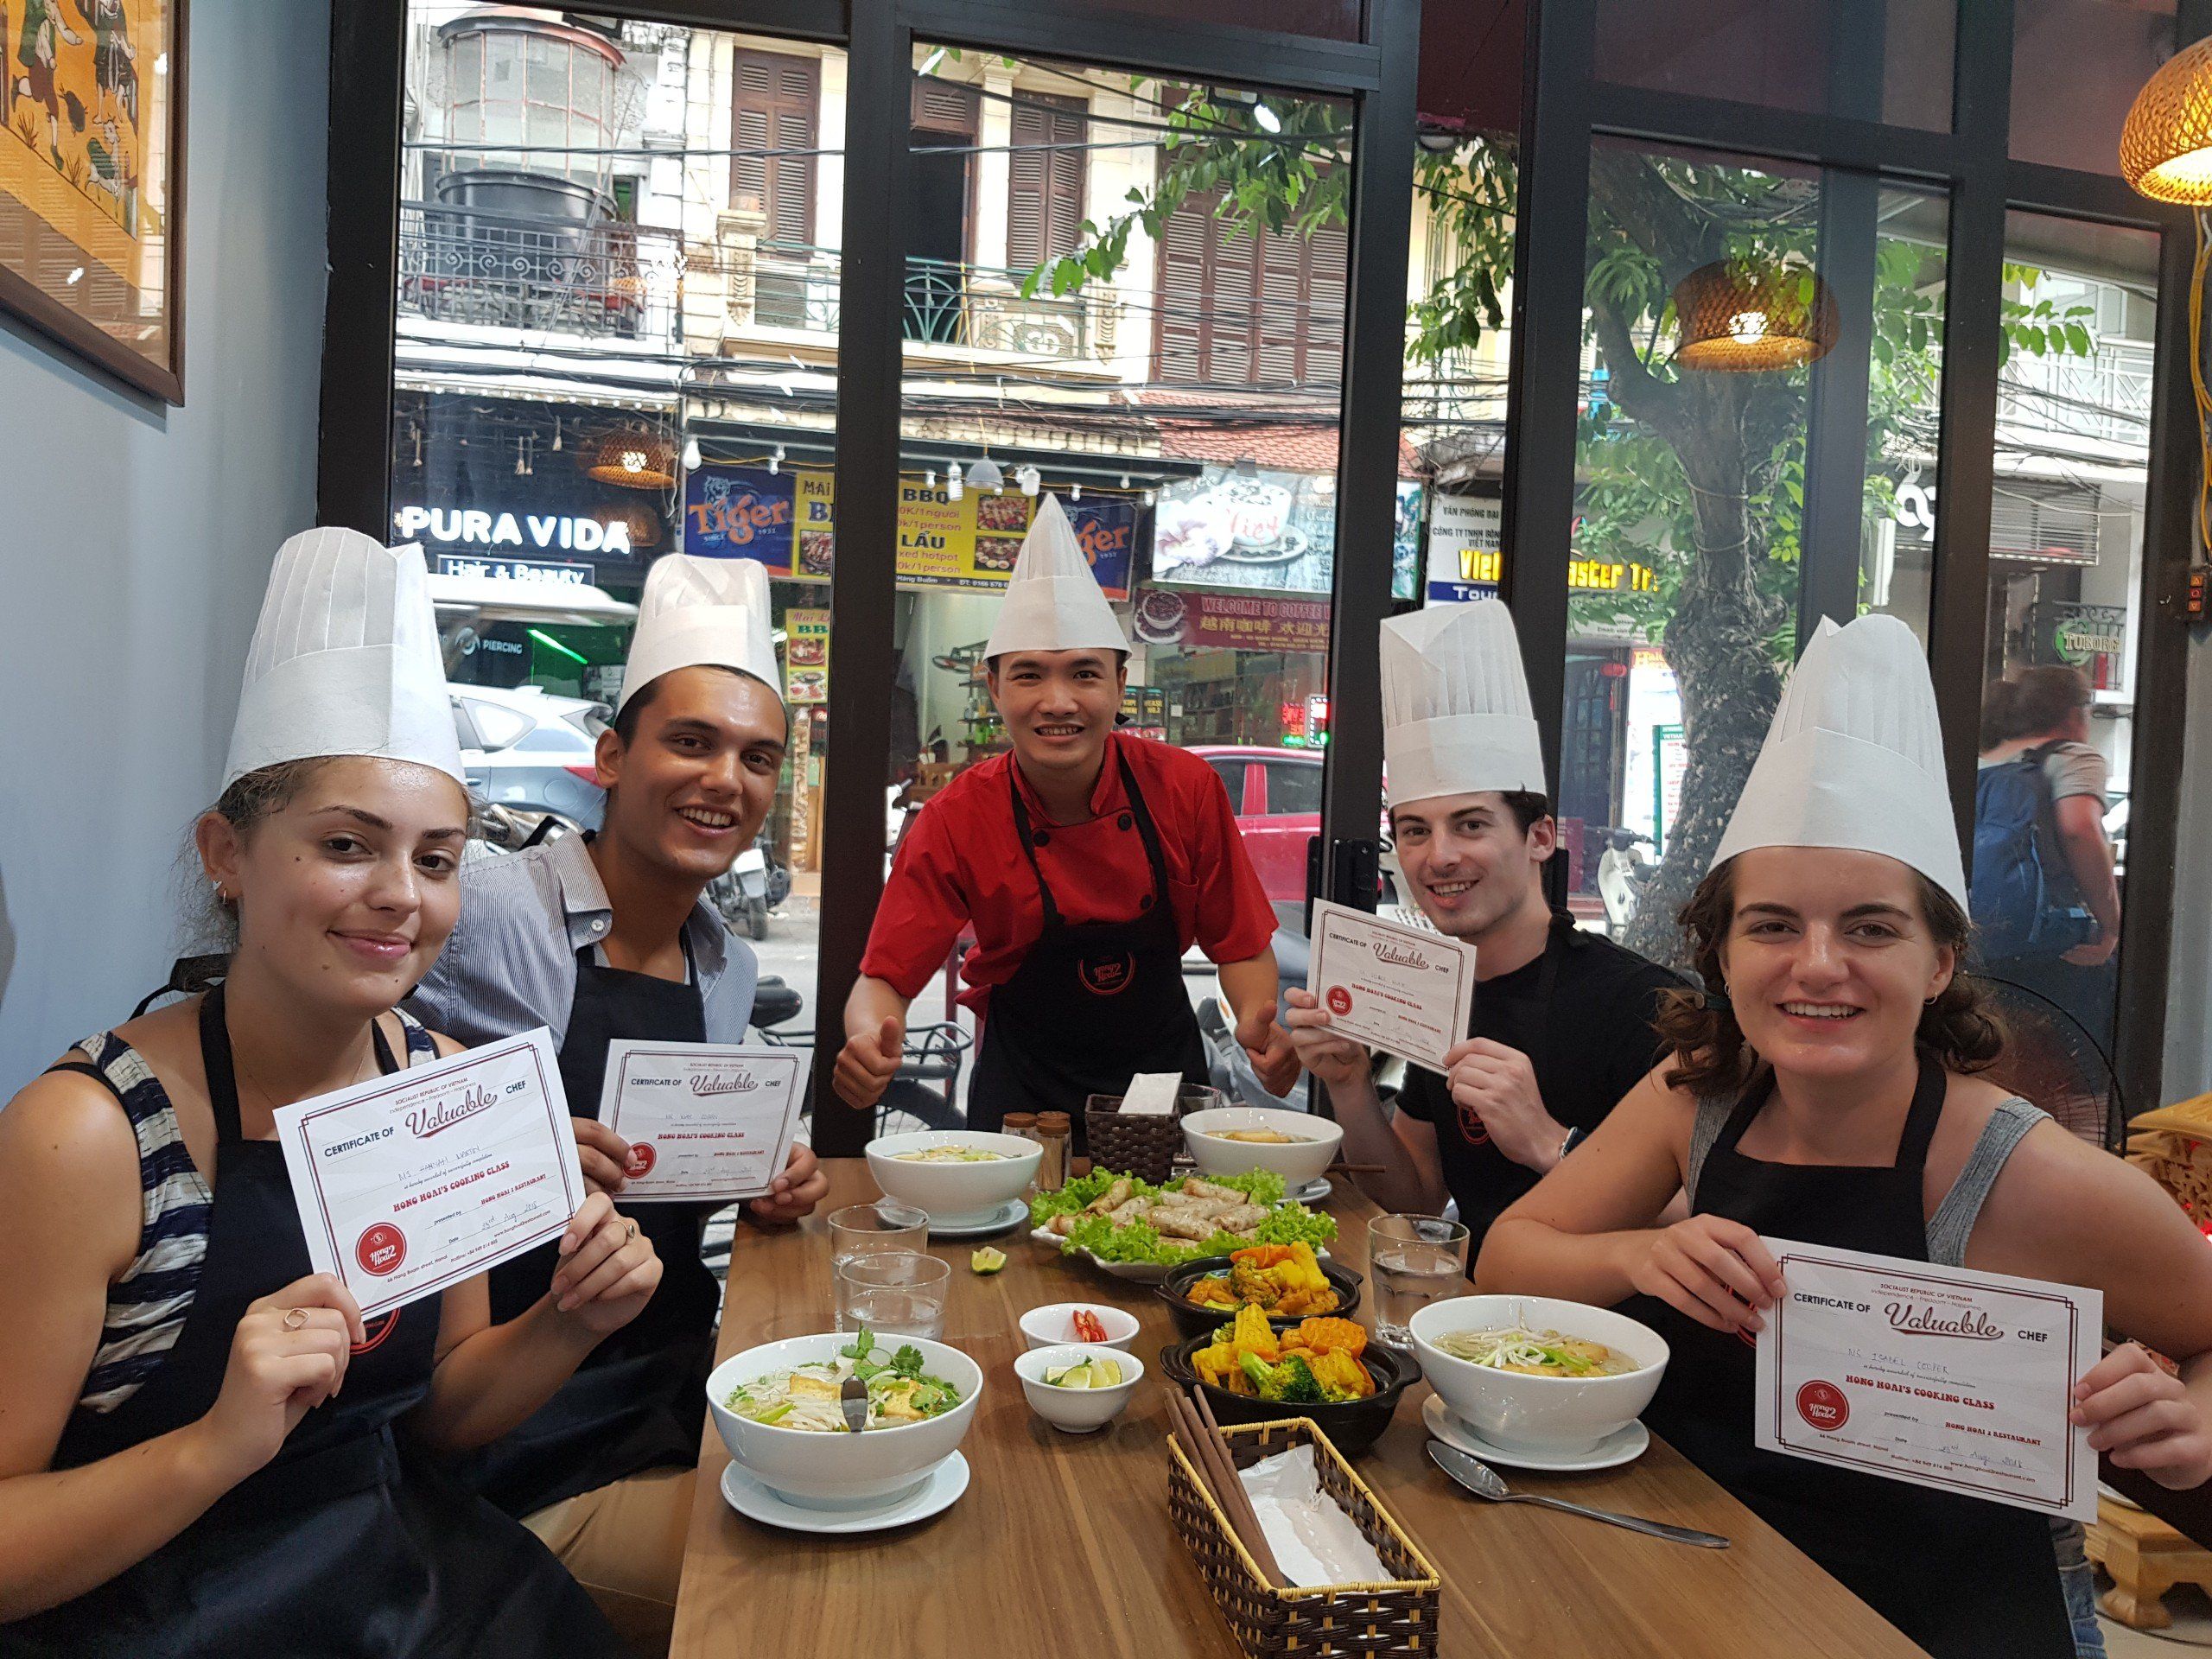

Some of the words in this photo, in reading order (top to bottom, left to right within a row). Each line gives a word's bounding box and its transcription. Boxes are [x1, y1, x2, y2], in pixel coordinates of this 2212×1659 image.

[904, 489, 949, 505] BBQ
[688, 493, 789, 544] Tiger
[402, 506, 523, 545] PURA
[527, 516, 630, 554] VIDA
[921, 551, 957, 562] hotpot
[1201, 596, 1262, 615] WELCOME
[1263, 602, 1277, 617] TO
[1279, 603, 1322, 619] COFFEE
[798, 626, 828, 634] BB
[483, 639, 522, 654] PIERCING
[2063, 632, 2120, 653] TUBORG
[1329, 933, 1358, 945] CERTIFICATE
[1373, 943, 1429, 968] Valuable
[690, 1072, 759, 1093] Valuable
[396, 1092, 418, 1105] SOCIALIST
[420, 1085, 440, 1097] REPUBLIC
[325, 1132, 380, 1157] CERTIFICATE
[382, 1127, 394, 1137] OF
[405, 1084, 498, 1135] Valuable
[505, 1080, 526, 1094] CHEF
[393, 1197, 418, 1212] HONG
[420, 1185, 448, 1202] HOAI'S
[450, 1172, 486, 1191] COOKING
[486, 1161, 510, 1175] CLASS
[481, 1194, 496, 1205] HONG
[497, 1189, 510, 1199] HOAI
[515, 1173, 546, 1192] RESTAURANT
[434, 1213, 455, 1225] presented
[1880, 1284, 1910, 1293] SOCIALIST
[1794, 1293, 1853, 1310] CERTIFICATE
[1856, 1303, 1870, 1313] OF
[1884, 1303, 2005, 1338] Valuable
[2018, 1330, 2048, 1343] CHEF
[1846, 1375, 1873, 1387] HONG
[1877, 1381, 1911, 1395] HOAI'S
[1914, 1388, 1960, 1403] COOKING
[1963, 1397, 1995, 1410] CLASS
[1885, 1412, 1911, 1421] presented
[1946, 1422, 1965, 1431] HONG
[1967, 1426, 1986, 1435] HOAI
[1993, 1431, 2041, 1446] RESTAURANT
